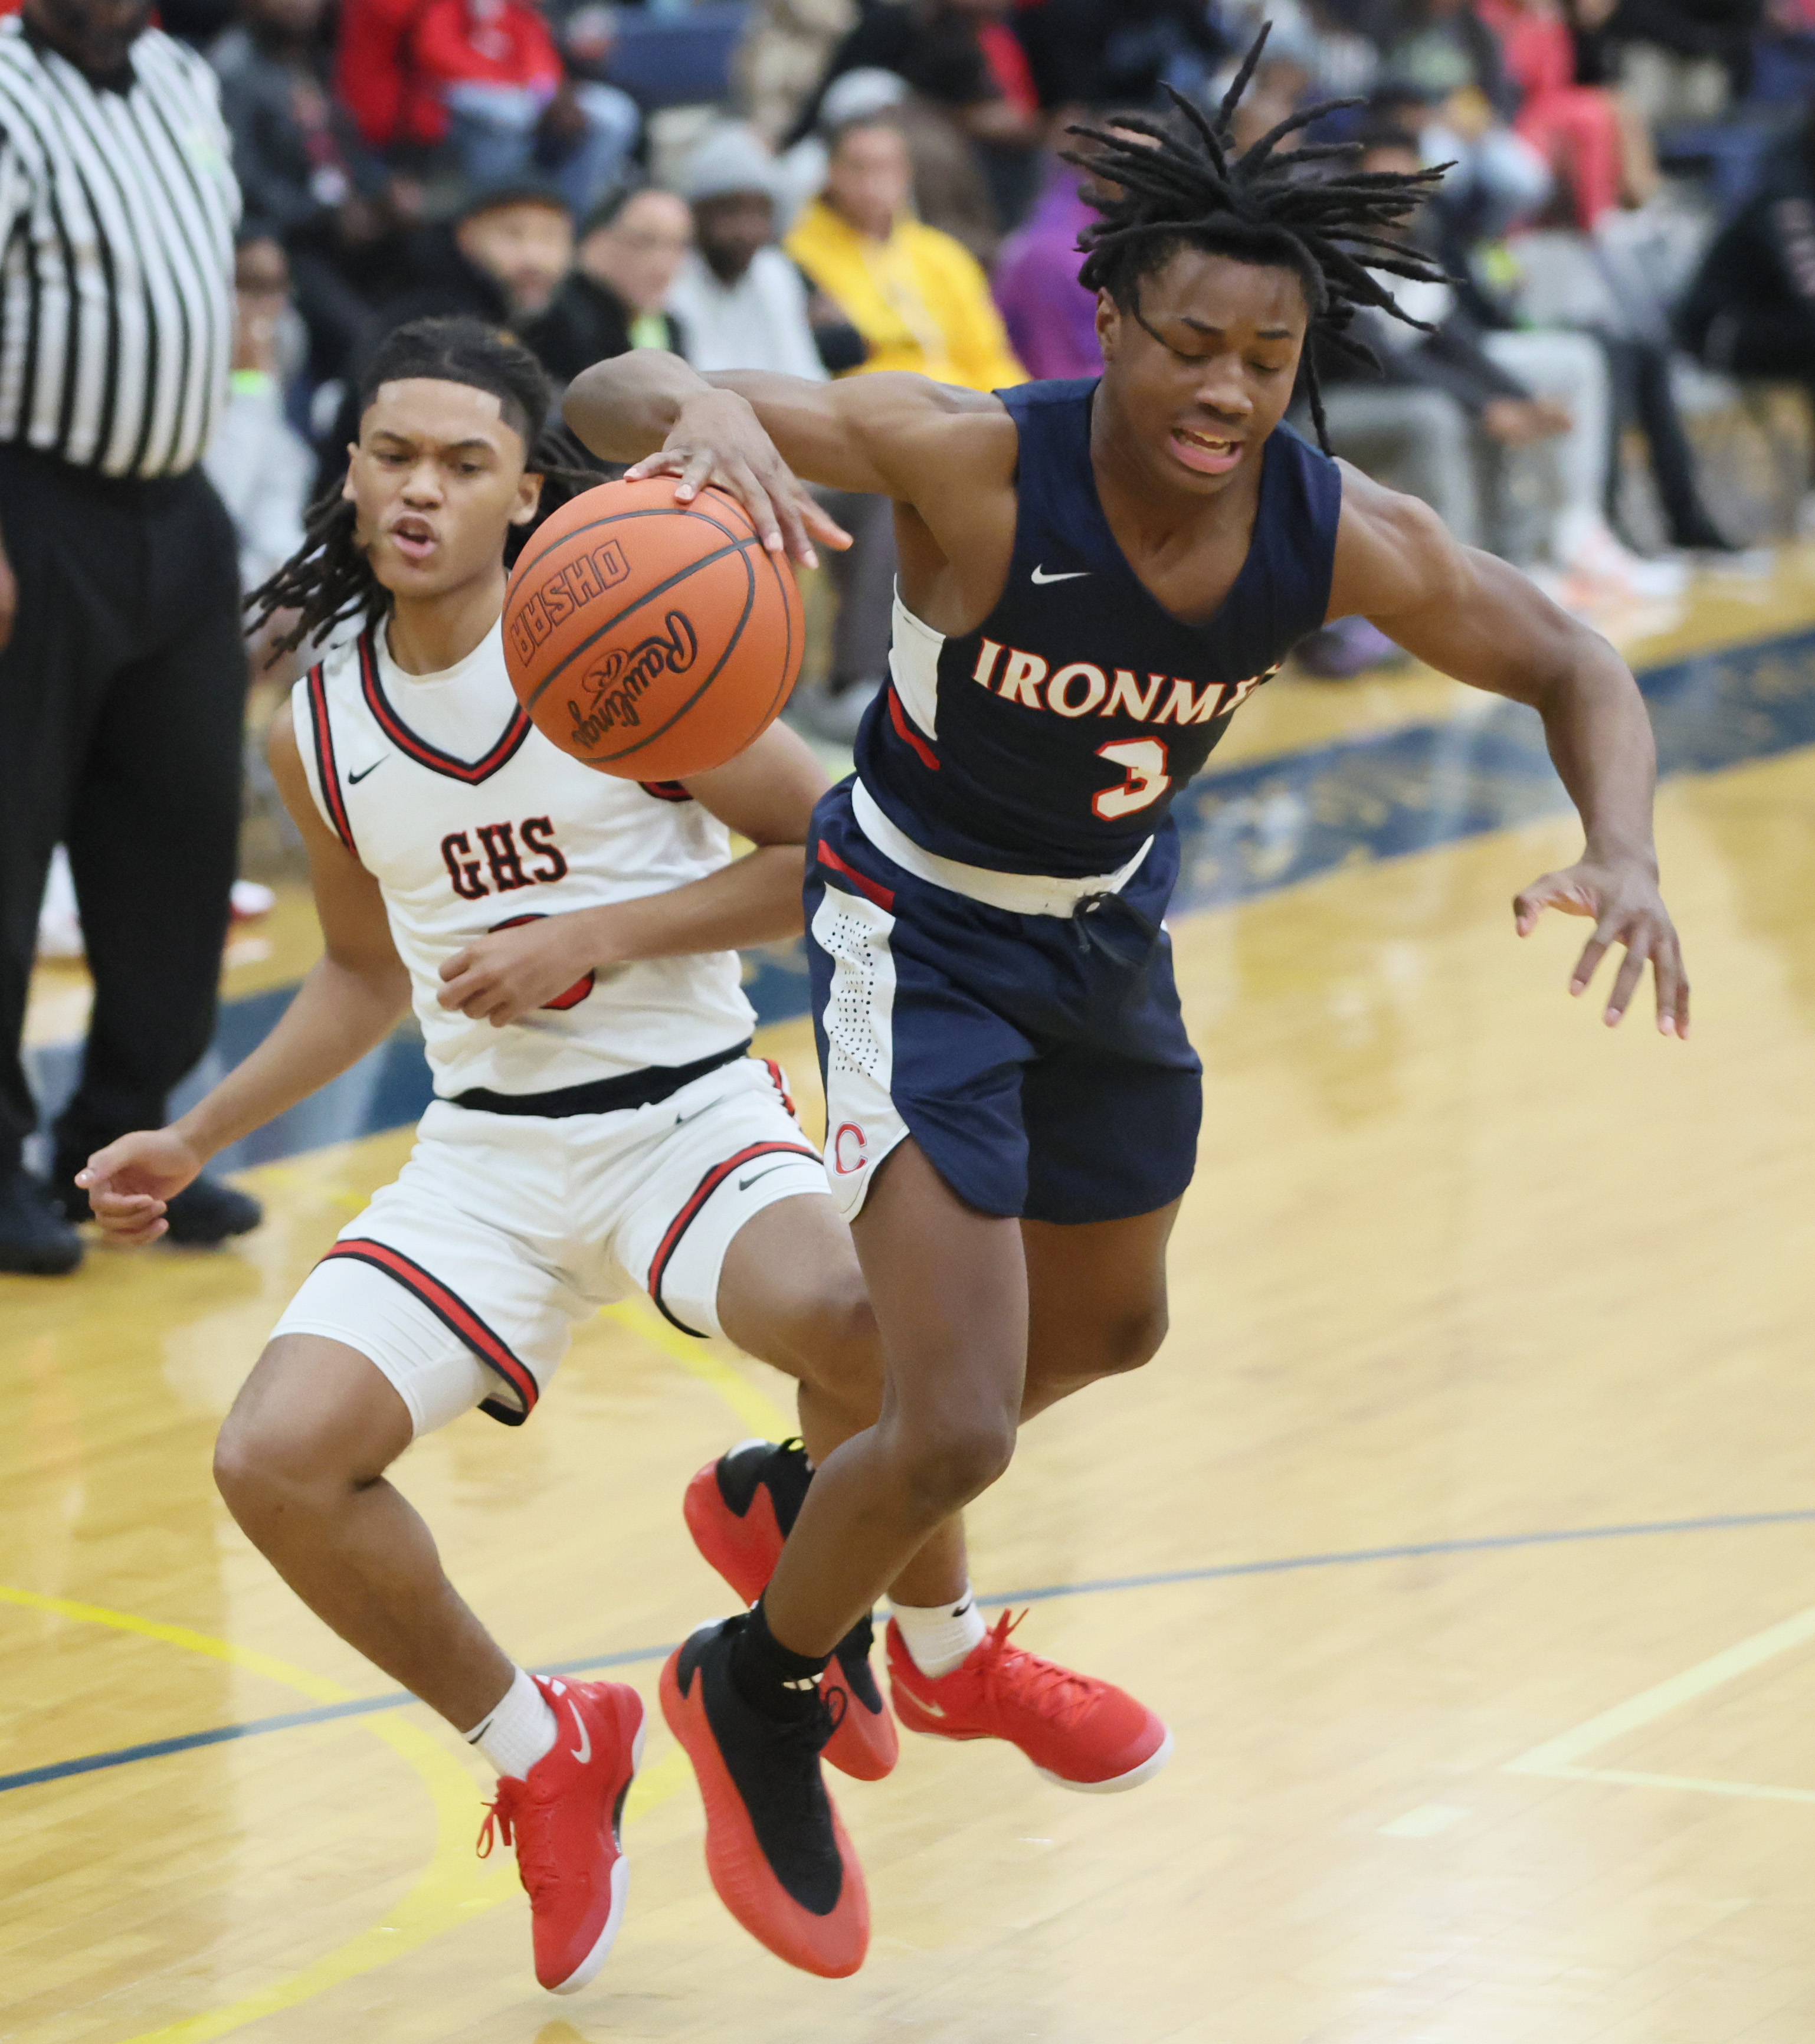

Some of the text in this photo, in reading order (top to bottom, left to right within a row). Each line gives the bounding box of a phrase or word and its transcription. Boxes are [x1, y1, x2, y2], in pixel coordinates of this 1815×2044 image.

[510, 539, 631, 668] OHSAA
[568, 610, 698, 749] Rawlings
[971, 637, 1281, 726] IRONME
[1092, 735, 1172, 822] 3
[440, 815, 568, 900] GHS
[833, 1121, 868, 1177] C
